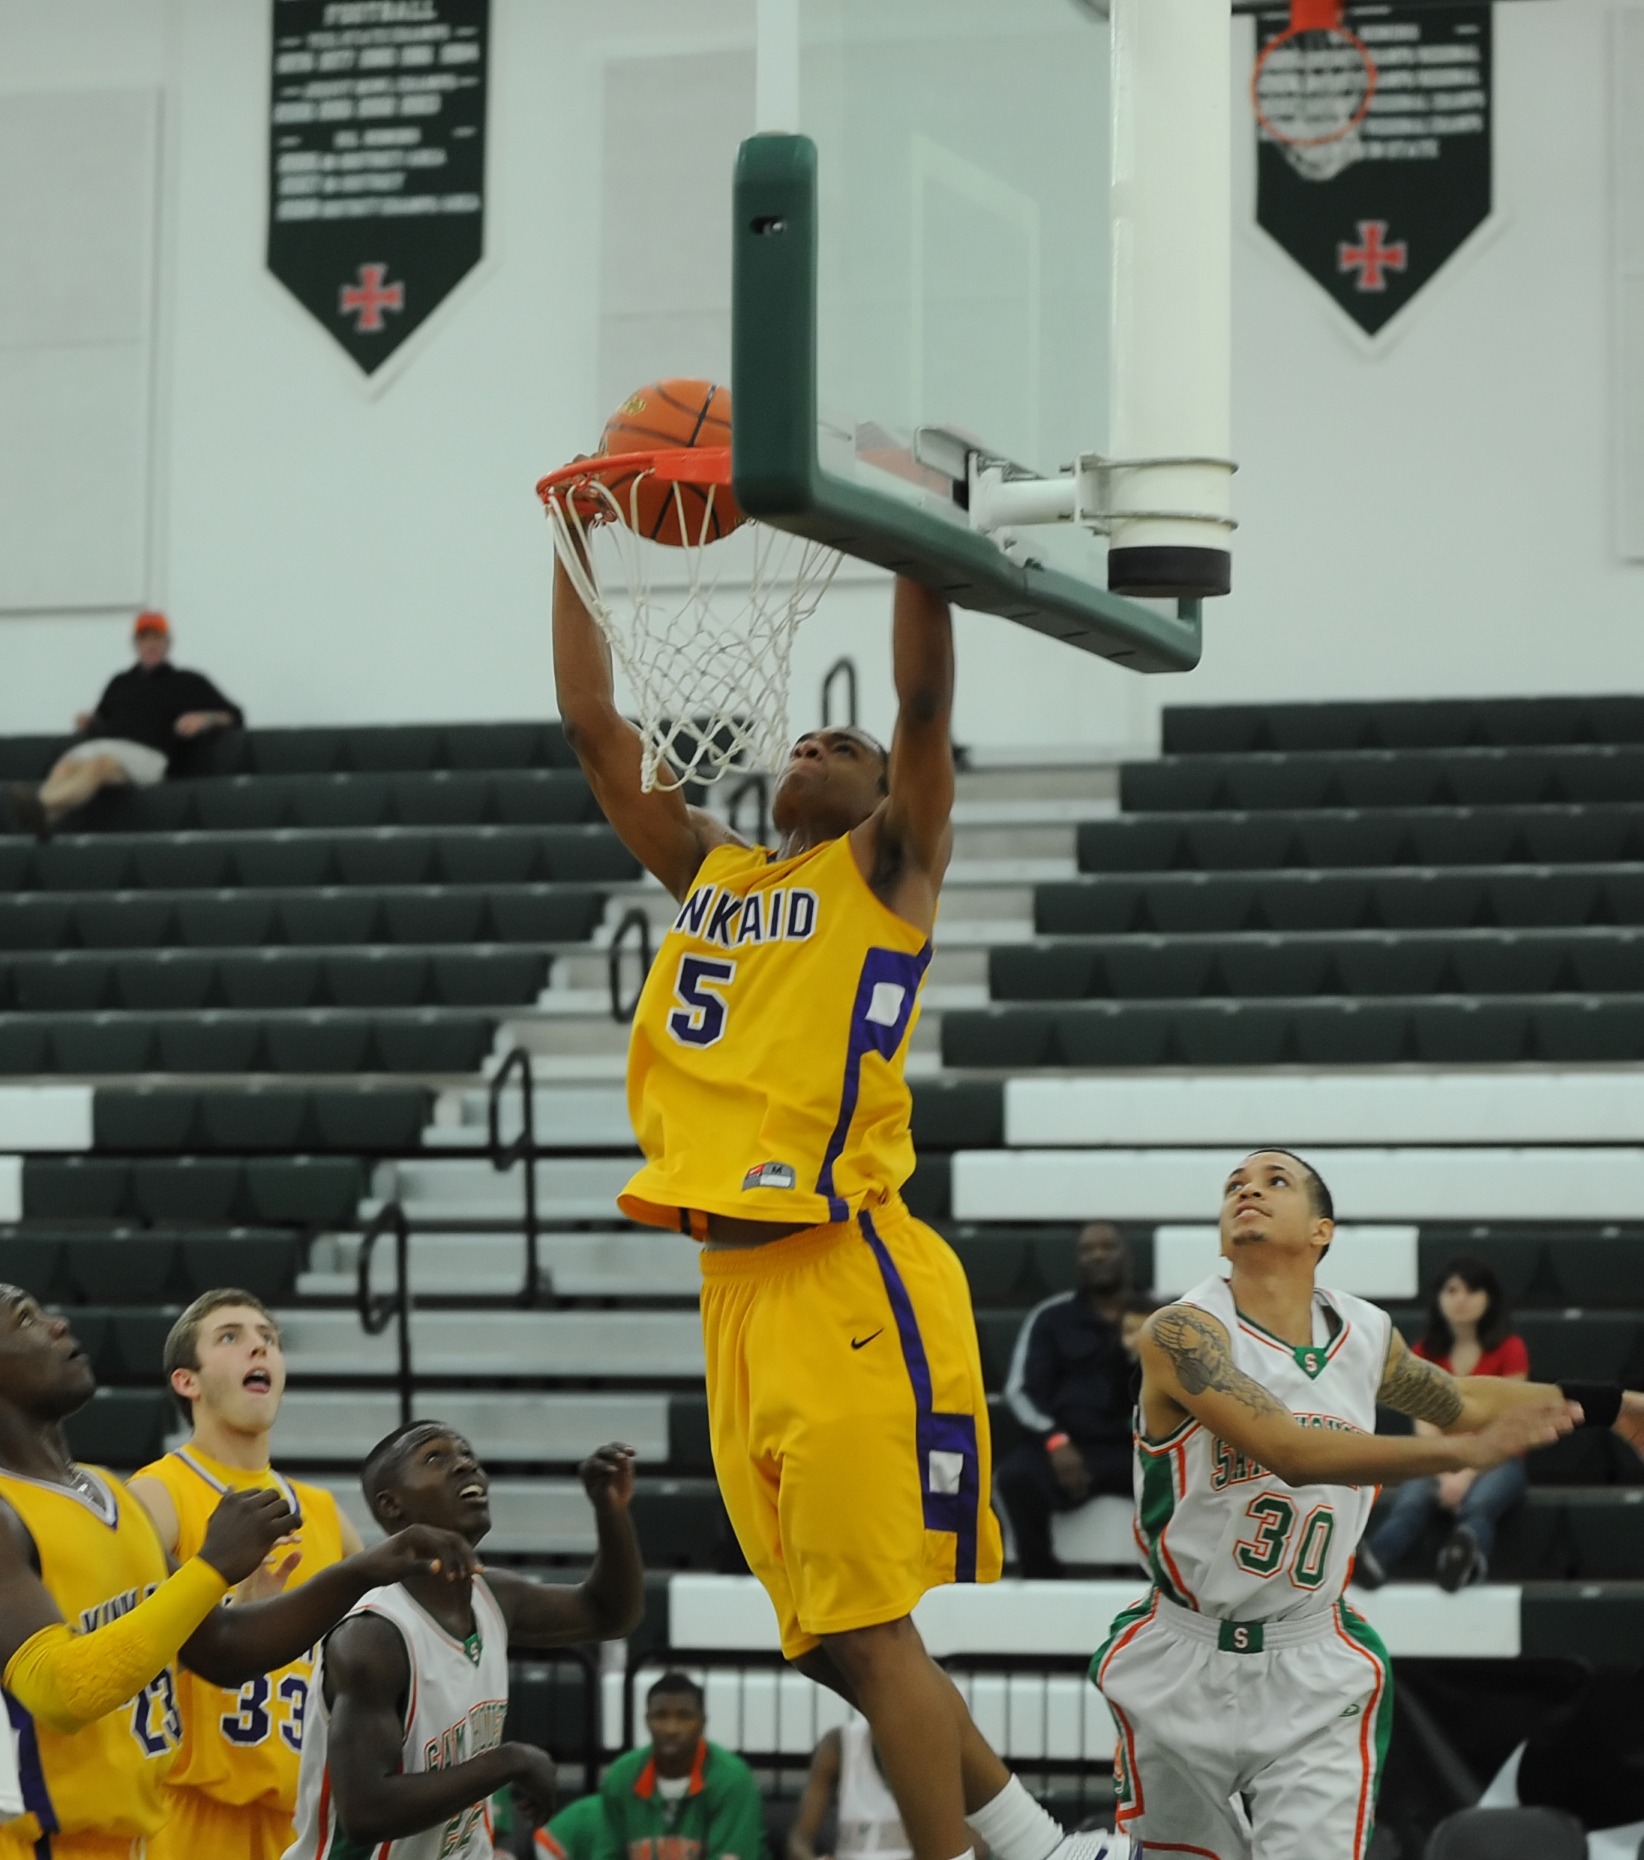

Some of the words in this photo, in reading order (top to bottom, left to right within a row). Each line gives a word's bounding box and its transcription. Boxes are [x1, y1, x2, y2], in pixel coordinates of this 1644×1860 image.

[666, 952, 737, 1050] 5
[1304, 1352, 1319, 1373] S
[1233, 1491, 1336, 1591] 30
[1233, 1627, 1249, 1649] S
[220, 1672, 308, 1756] 33
